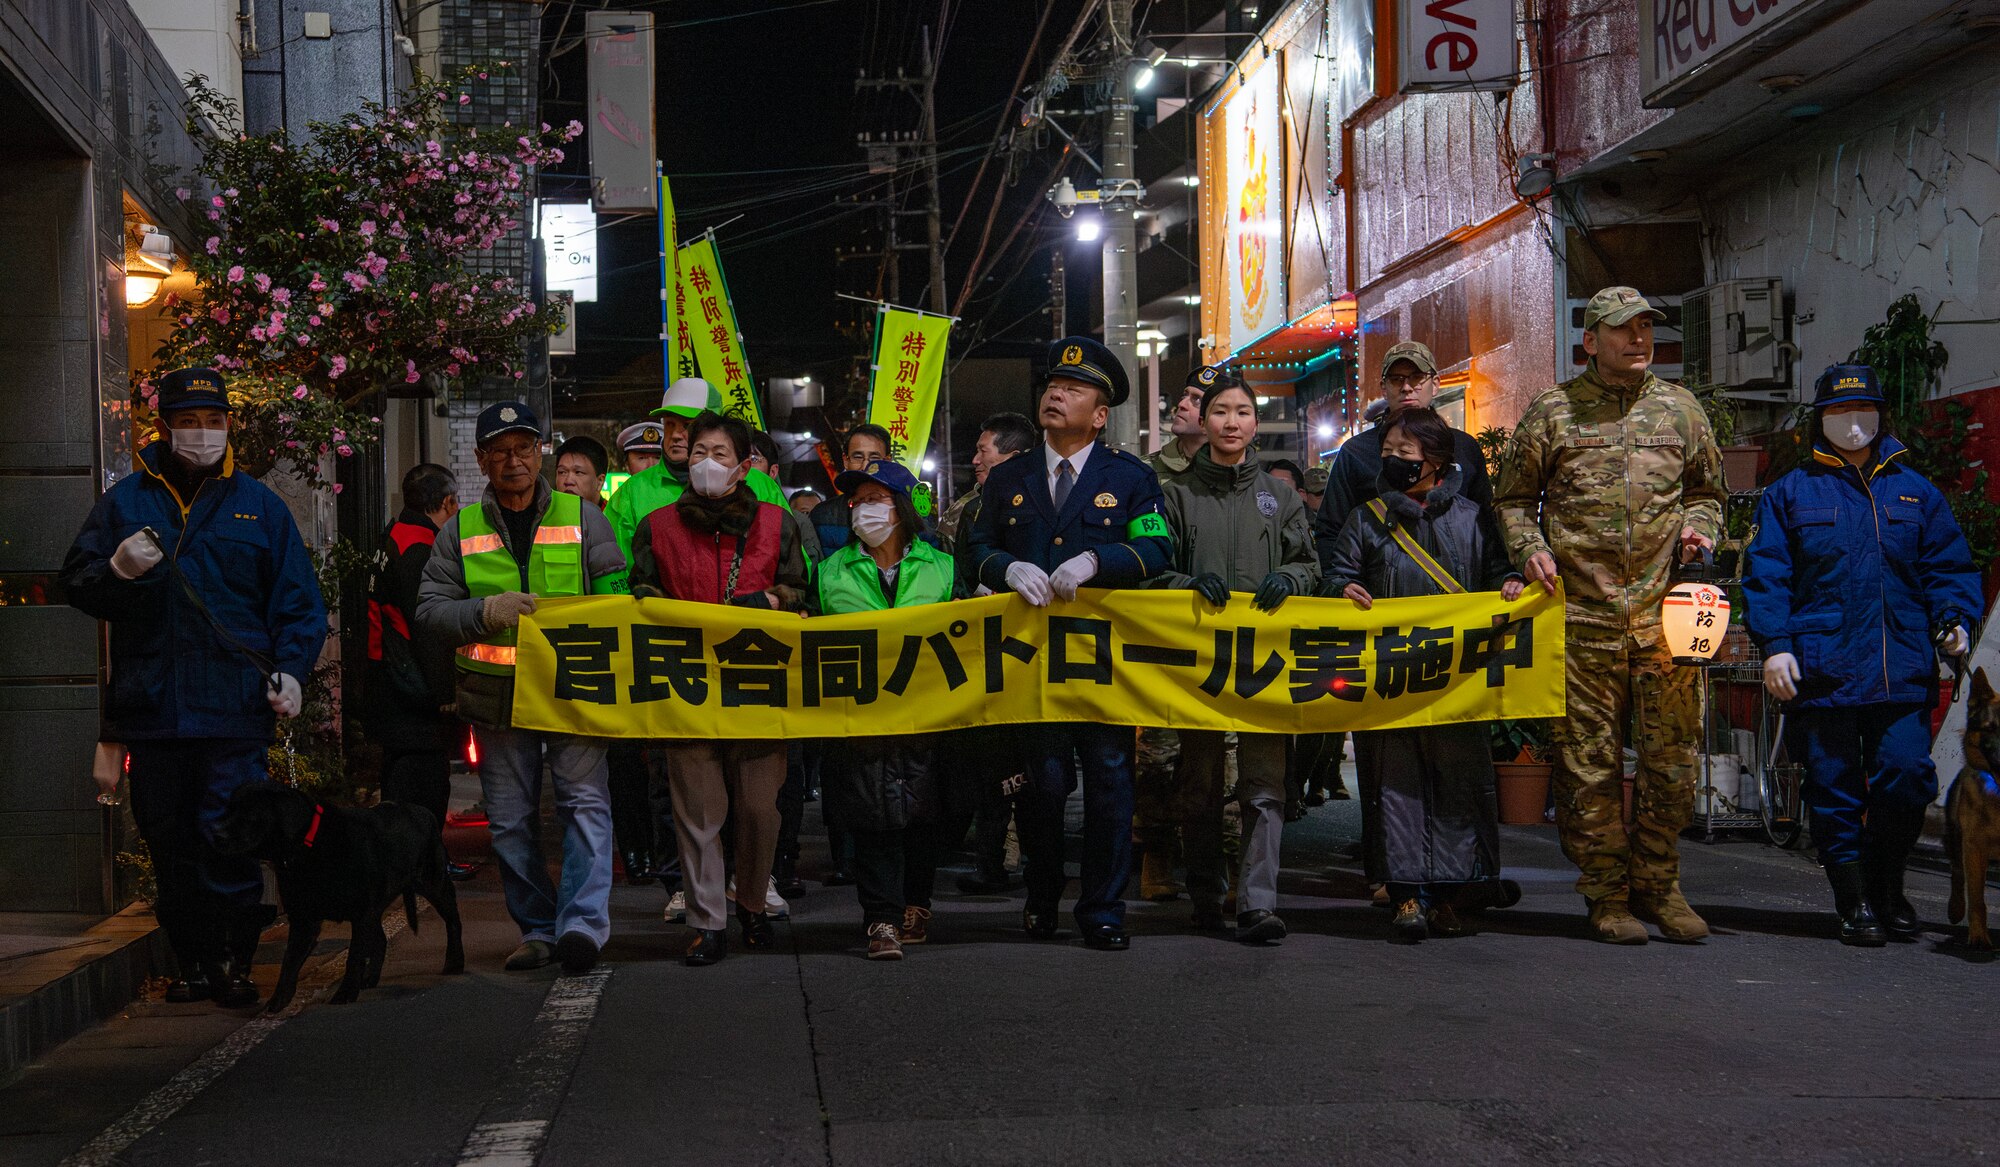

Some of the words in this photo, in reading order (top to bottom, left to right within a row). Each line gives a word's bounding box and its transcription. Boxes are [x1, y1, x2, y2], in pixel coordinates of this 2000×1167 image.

[1141, 517, 1161, 533] 防
[1688, 611, 1716, 653] 防犯
[541, 612, 1534, 708] 官民合同パトロール実施中
